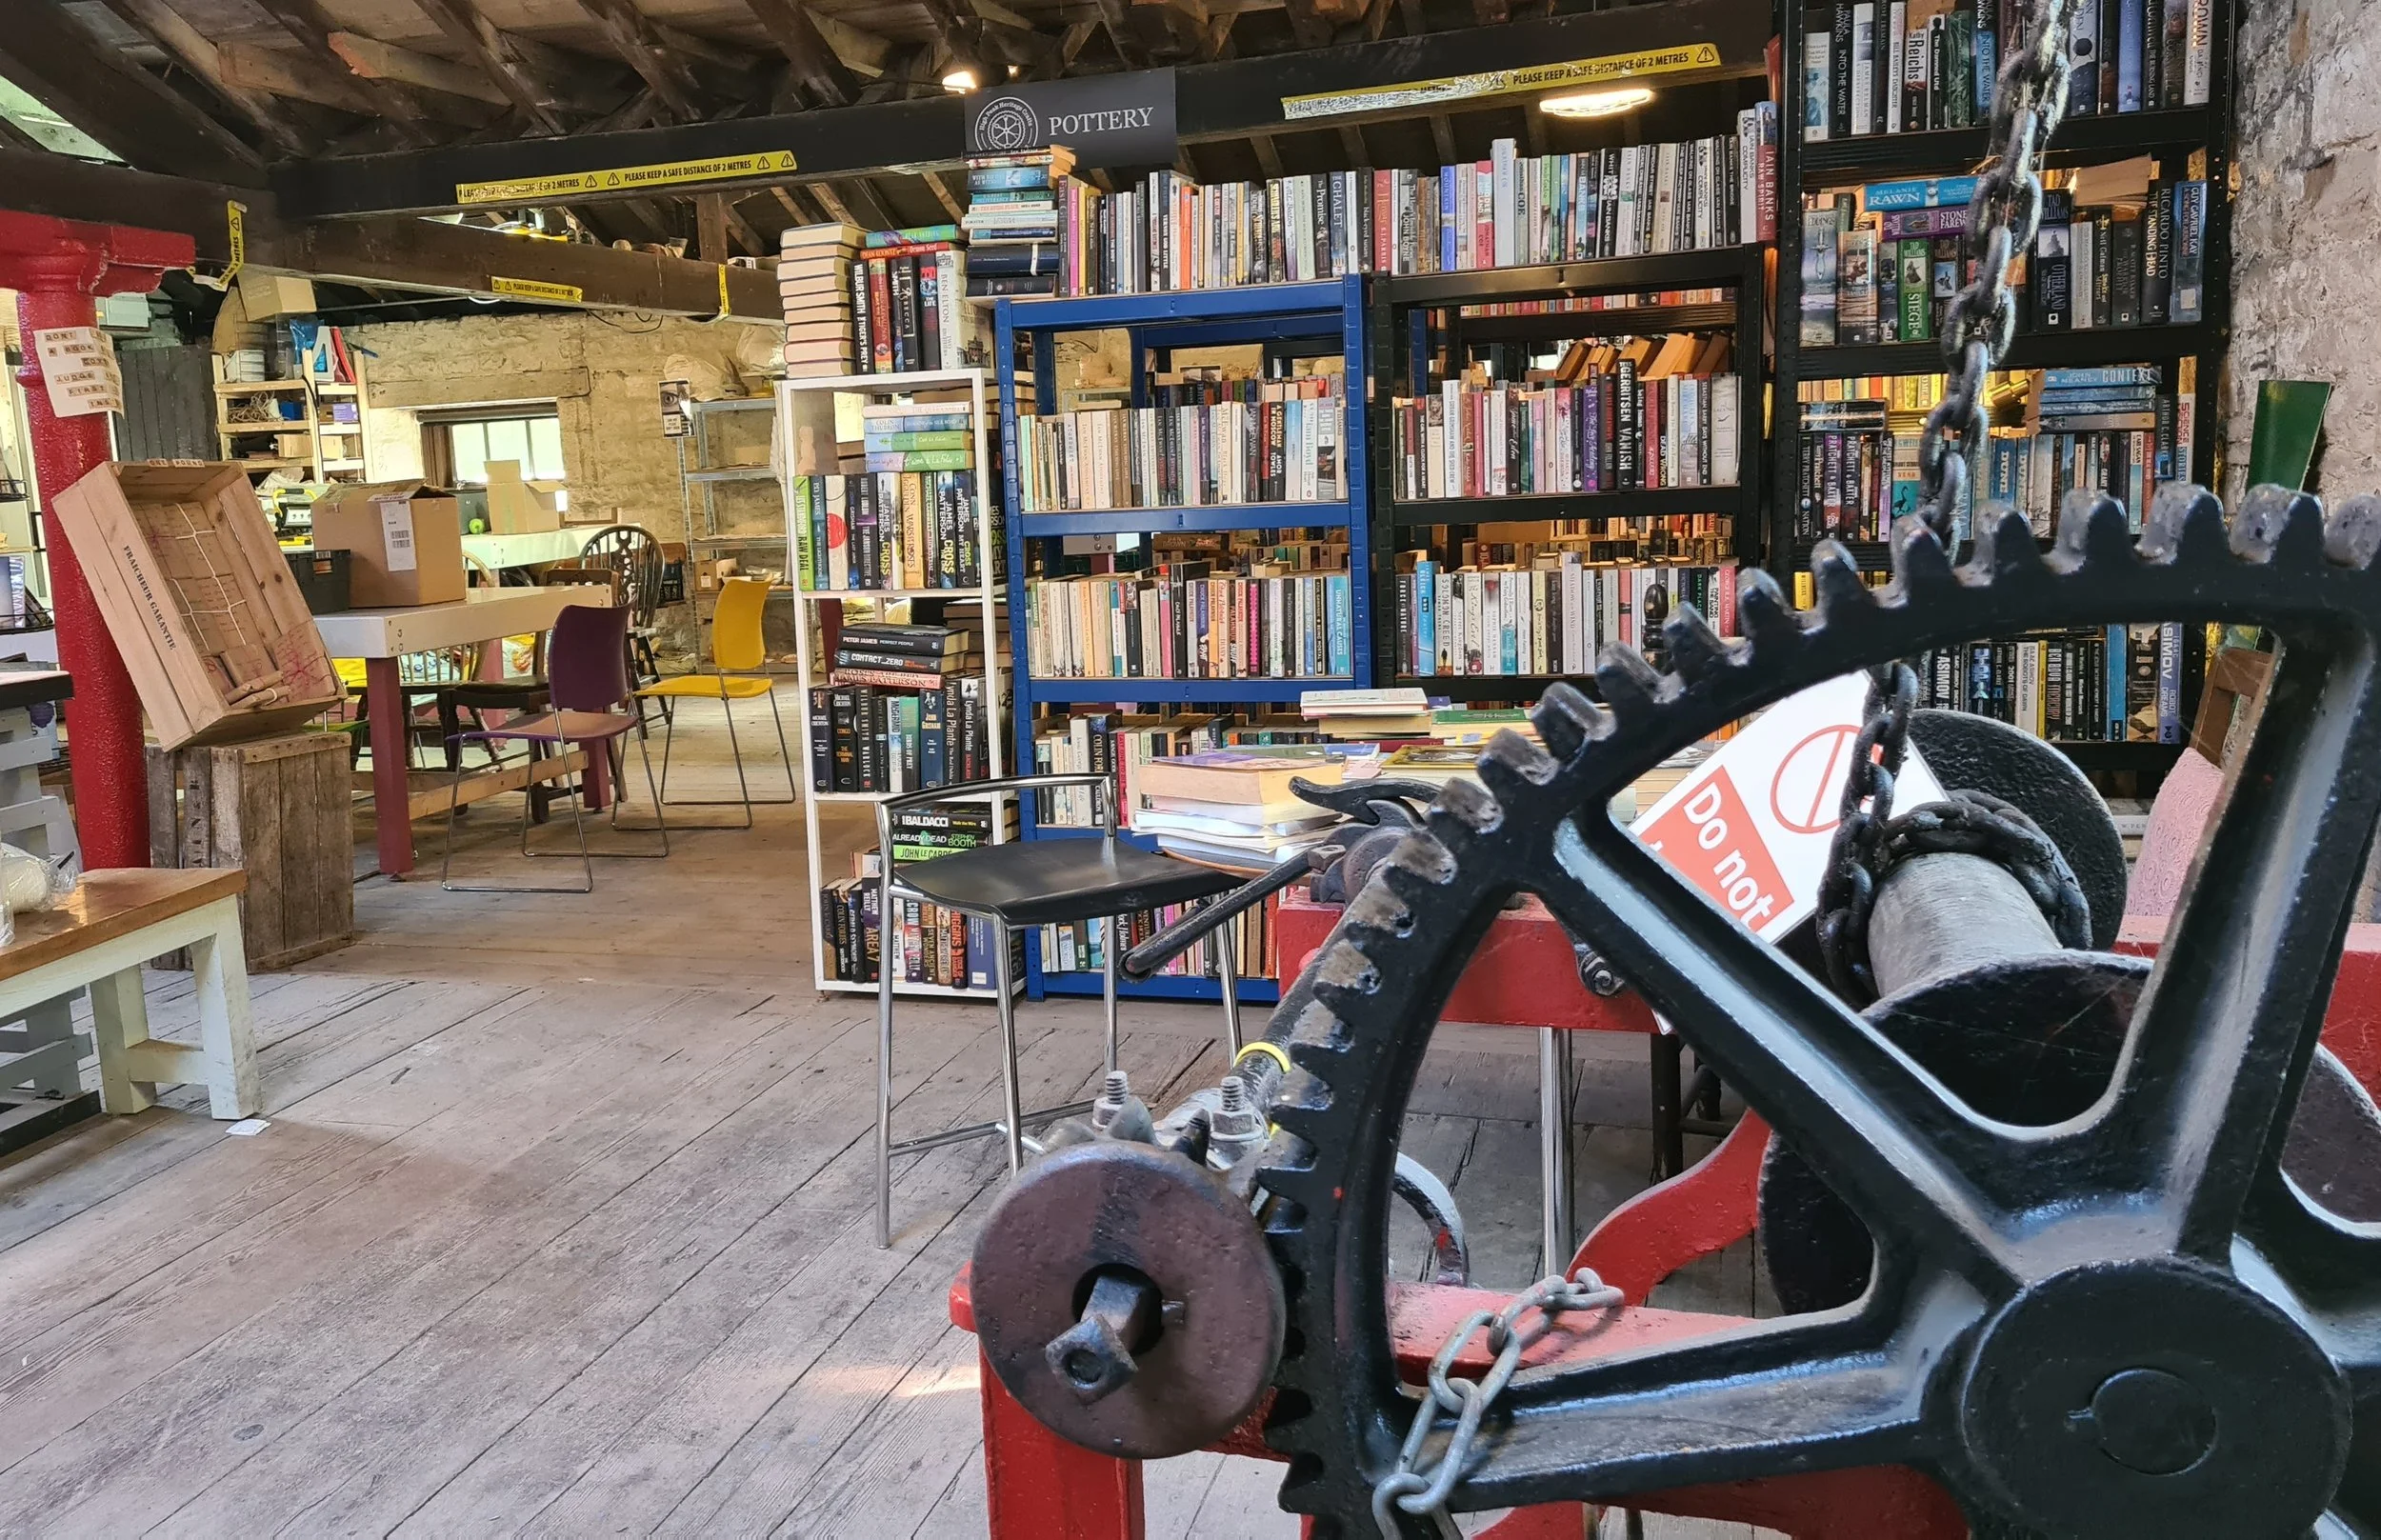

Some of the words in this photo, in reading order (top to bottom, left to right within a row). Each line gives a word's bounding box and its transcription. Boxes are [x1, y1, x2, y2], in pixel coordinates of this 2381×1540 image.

[1835, 3, 1844, 43] HAWKINS
[1513, 71, 1542, 85] PLEASE
[1544, 68, 1564, 81] KEEP
[1566, 68, 1571, 78] A
[1573, 65, 1593, 76] SAFE
[1636, 58, 1646, 70] OF
[1648, 57, 1653, 67] 2
[1654, 52, 1689, 65] METRES
[1838, 49, 1847, 70] INTO
[1908, 39, 1925, 80] Reichs
[1837, 72, 1846, 86] THE
[1836, 89, 1846, 115] WATER
[979, 118, 989, 130] High
[986, 103, 999, 118] Peak
[999, 102, 1023, 111] Heritage
[1022, 109, 1032, 127] Crafts
[1049, 107, 1153, 136] POTTERY
[625, 172, 645, 181] PLEASE
[668, 169, 682, 177] SAFE
[683, 166, 712, 175] DISTANCE
[728, 161, 750, 170] METRES
[1766, 150, 1774, 175] IAIN
[557, 180, 579, 189] METRES
[1317, 189, 1326, 225] Promise
[1333, 181, 1343, 228] CHALET
[1517, 192, 1526, 215] COE
[1765, 182, 1774, 221] BANKS
[1869, 192, 1921, 206] RAWN
[1940, 210, 1968, 219] STONE
[2160, 189, 2171, 239] RICARDO
[2147, 210, 2159, 252] STANDING
[2158, 245, 2171, 279] PINTO
[854, 264, 864, 292] WILBUR
[2051, 264, 2066, 310] OTHERLAND
[856, 291, 866, 313] SMITH
[1908, 293, 1920, 330] SIEGE
[2102, 369, 2151, 382] CONTEXT
[1620, 367, 1632, 422] GERRITSEN
[1619, 428, 1632, 470] VANISH
[1828, 435, 1837, 473] PRATCHETT
[1847, 436, 1855, 472] PRATCHETT
[1846, 480, 1854, 505] BAXTER
[798, 536, 808, 553] RAW
[958, 534, 965, 546] MY
[799, 554, 809, 571] DEAL
[882, 541, 890, 575] CROSS
[945, 539, 954, 574] CROSS
[124, 546, 152, 601] FRAICHEUR
[150, 601, 177, 650] GARANTIE
[871, 676, 926, 687] PATTERSON
[1936, 656, 1951, 699] ASIMOV
[860, 689, 869, 717] WILBUR
[946, 682, 957, 706] Lynda
[947, 708, 956, 717] La
[964, 700, 973, 721] Lynda
[861, 719, 870, 741] SMITH
[947, 720, 957, 746] Plante
[965, 730, 973, 751] Plante
[1093, 734, 1103, 755] COLIN
[906, 816, 949, 827] BALDACCI
[928, 834, 947, 843] DEAD
[900, 848, 919, 858] JOHN
[1683, 781, 1728, 850] Do
[1712, 850, 1774, 929] not
[867, 927, 879, 953] AREA
